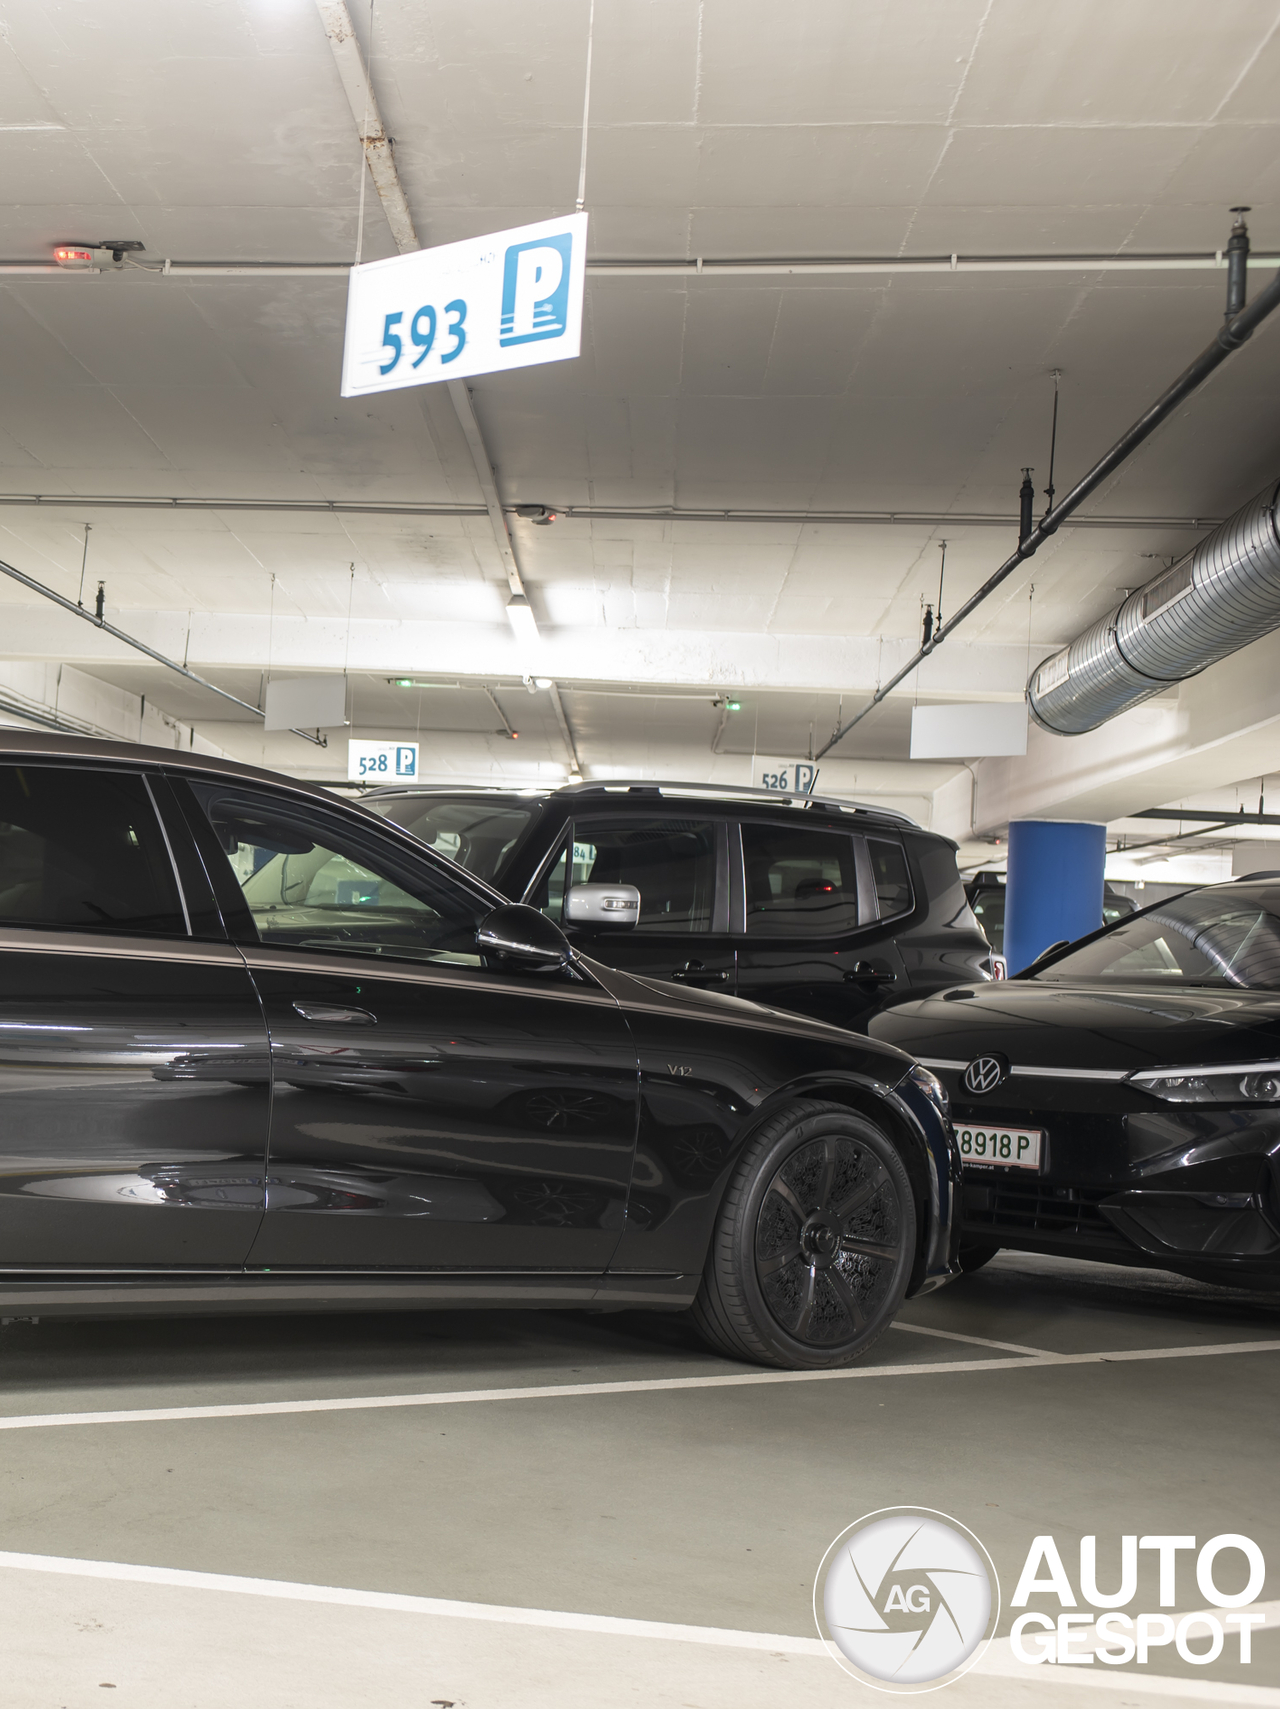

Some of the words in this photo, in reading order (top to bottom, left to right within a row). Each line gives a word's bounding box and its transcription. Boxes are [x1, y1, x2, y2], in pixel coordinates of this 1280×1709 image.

[378, 298, 469, 376] 593
[511, 246, 564, 340] P
[358, 753, 388, 775] 528
[762, 769, 788, 790] 526
[573, 846, 586, 861] 84
[667, 1064, 693, 1077] V12
